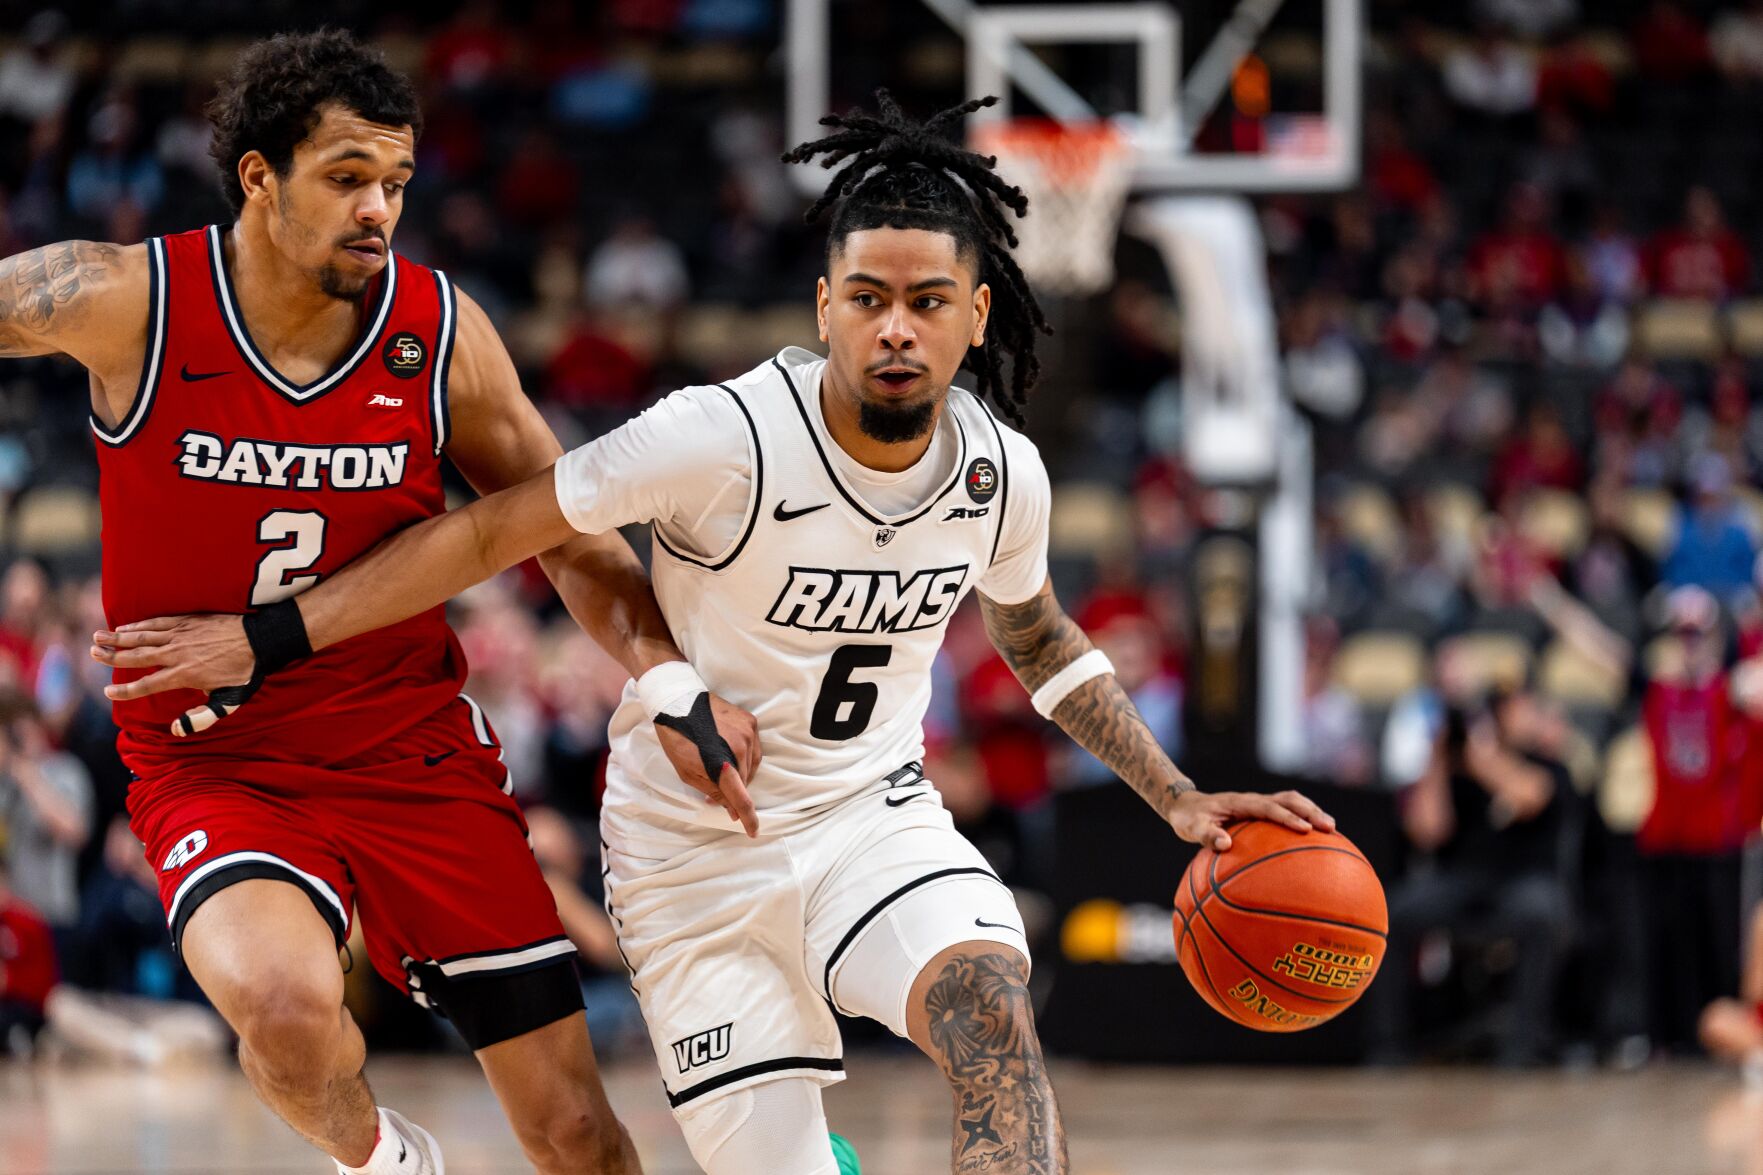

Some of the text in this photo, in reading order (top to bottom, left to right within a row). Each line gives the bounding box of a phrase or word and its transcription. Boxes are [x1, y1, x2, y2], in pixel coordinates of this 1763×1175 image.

[367, 394, 403, 407] A10
[174, 430, 409, 491] DAYTON
[941, 507, 989, 521] A10
[250, 508, 328, 605] 2
[765, 563, 969, 634] RAMS
[810, 644, 892, 741] 6
[1272, 953, 1373, 988] LEGACY
[671, 1022, 733, 1074] VCU
